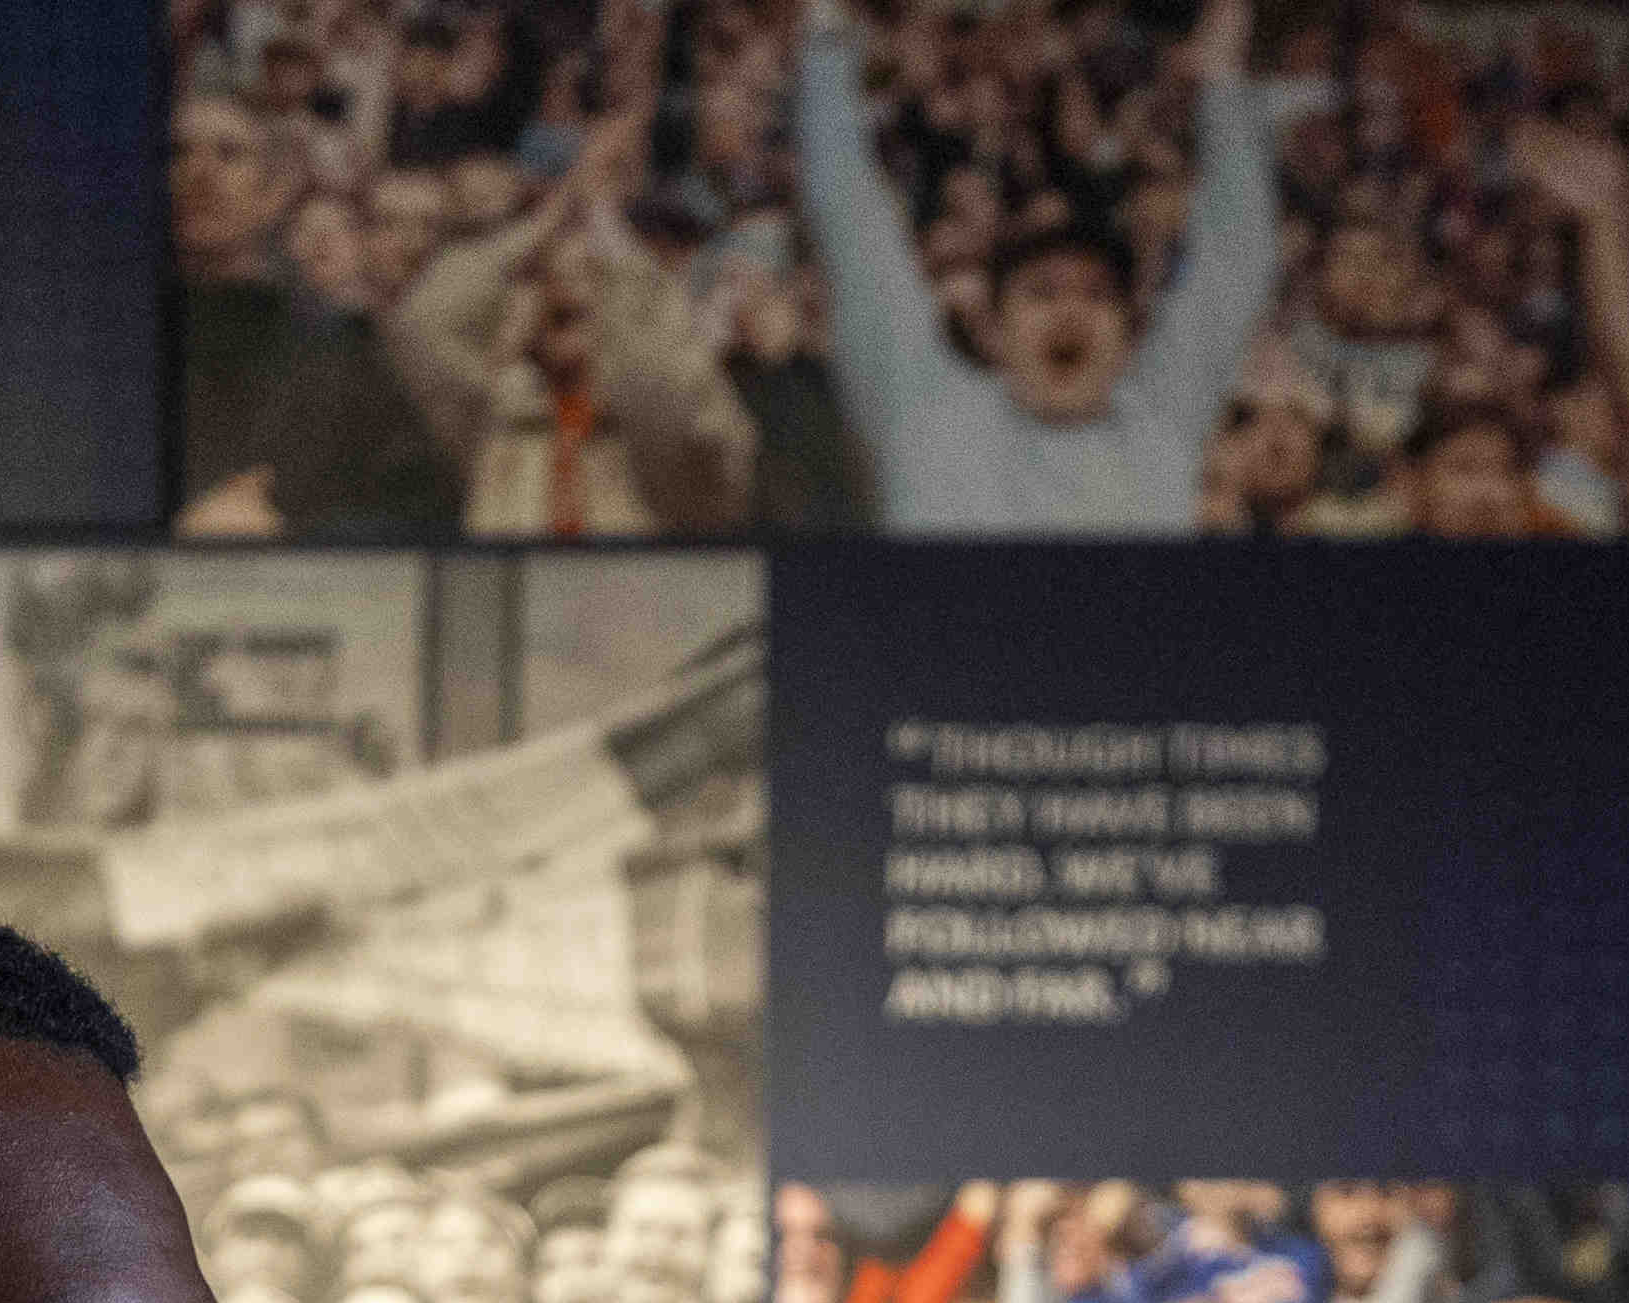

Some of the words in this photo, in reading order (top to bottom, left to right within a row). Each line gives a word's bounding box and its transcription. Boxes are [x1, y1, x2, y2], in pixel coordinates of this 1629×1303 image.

[1170, 720, 1328, 777] TIMES
[890, 782, 1025, 839] THEY
[1031, 782, 1170, 839] HAVE
[1177, 782, 1318, 842] BEEN
[884, 904, 1180, 960] FOLLOWED
[883, 964, 1012, 1024] AND
